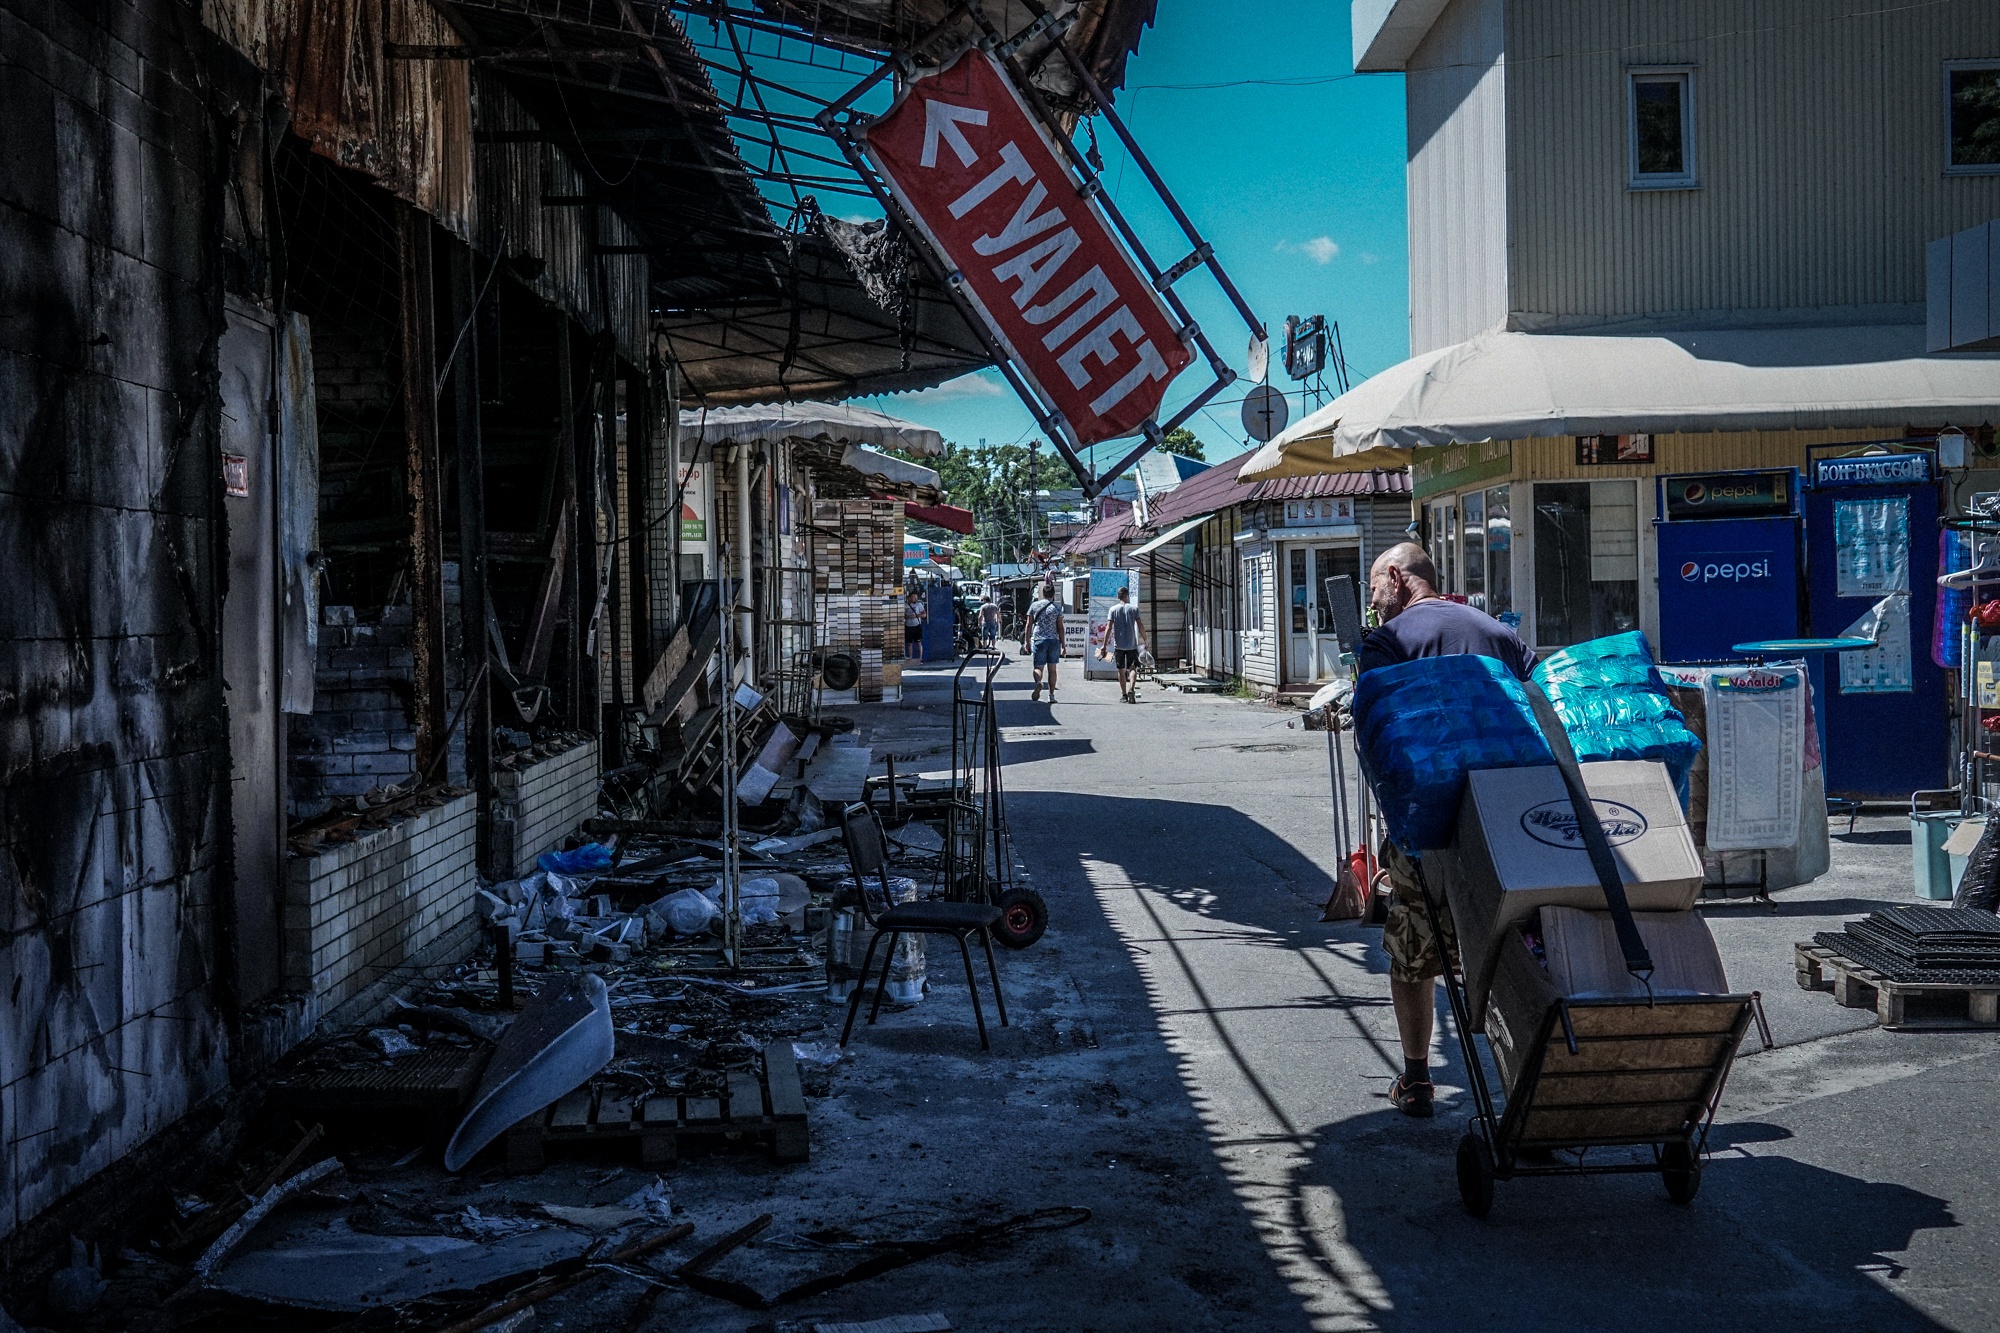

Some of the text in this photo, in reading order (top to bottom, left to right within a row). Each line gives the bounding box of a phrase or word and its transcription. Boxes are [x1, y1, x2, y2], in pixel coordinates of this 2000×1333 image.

[948, 140, 1168, 417] ТУАЛЕТ
[1711, 483, 1757, 500] pepsi
[1705, 559, 1768, 582] pepsi
[1729, 676, 1781, 689] Vonaldi
